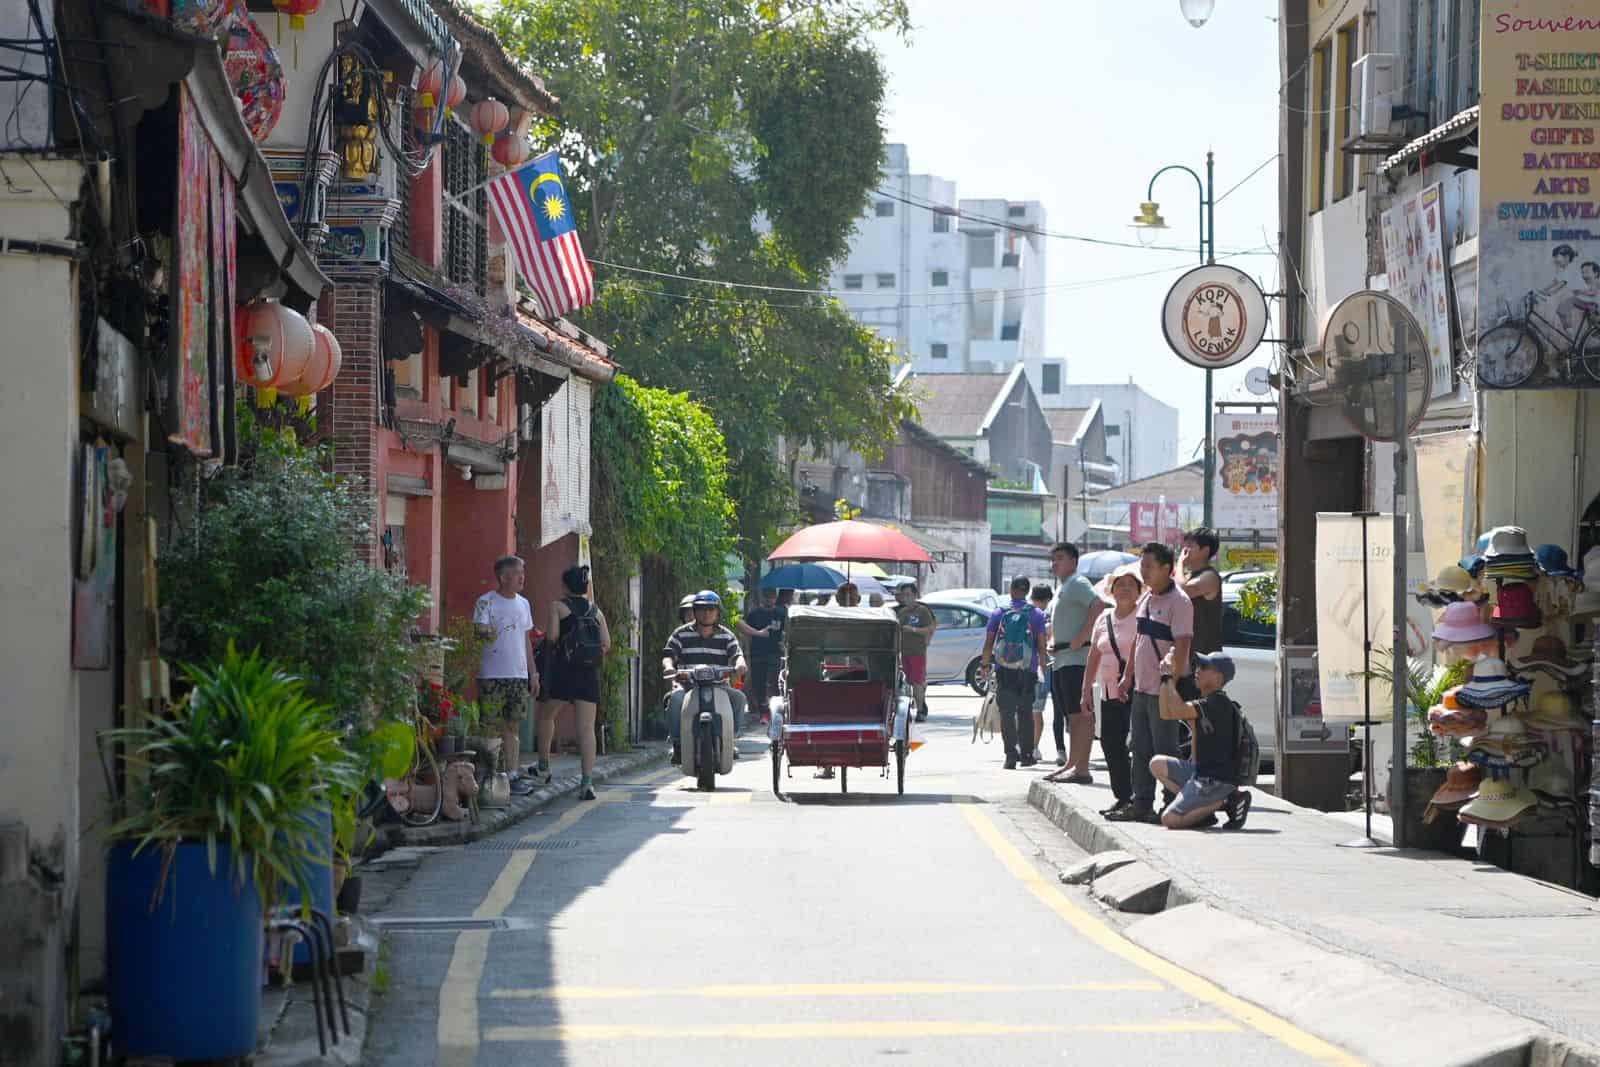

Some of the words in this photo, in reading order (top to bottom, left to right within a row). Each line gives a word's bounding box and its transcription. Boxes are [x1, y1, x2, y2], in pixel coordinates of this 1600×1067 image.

[1496, 14, 1600, 33] Souven
[1516, 53, 1600, 70] T-SHIRT
[1531, 128, 1594, 145] GIFTS
[1523, 153, 1600, 170] BATIKS
[1534, 177, 1590, 195] ARTS
[1519, 226, 1547, 241] and
[1195, 289, 1230, 305] KOPI
[1193, 327, 1236, 353] LOEWAK
